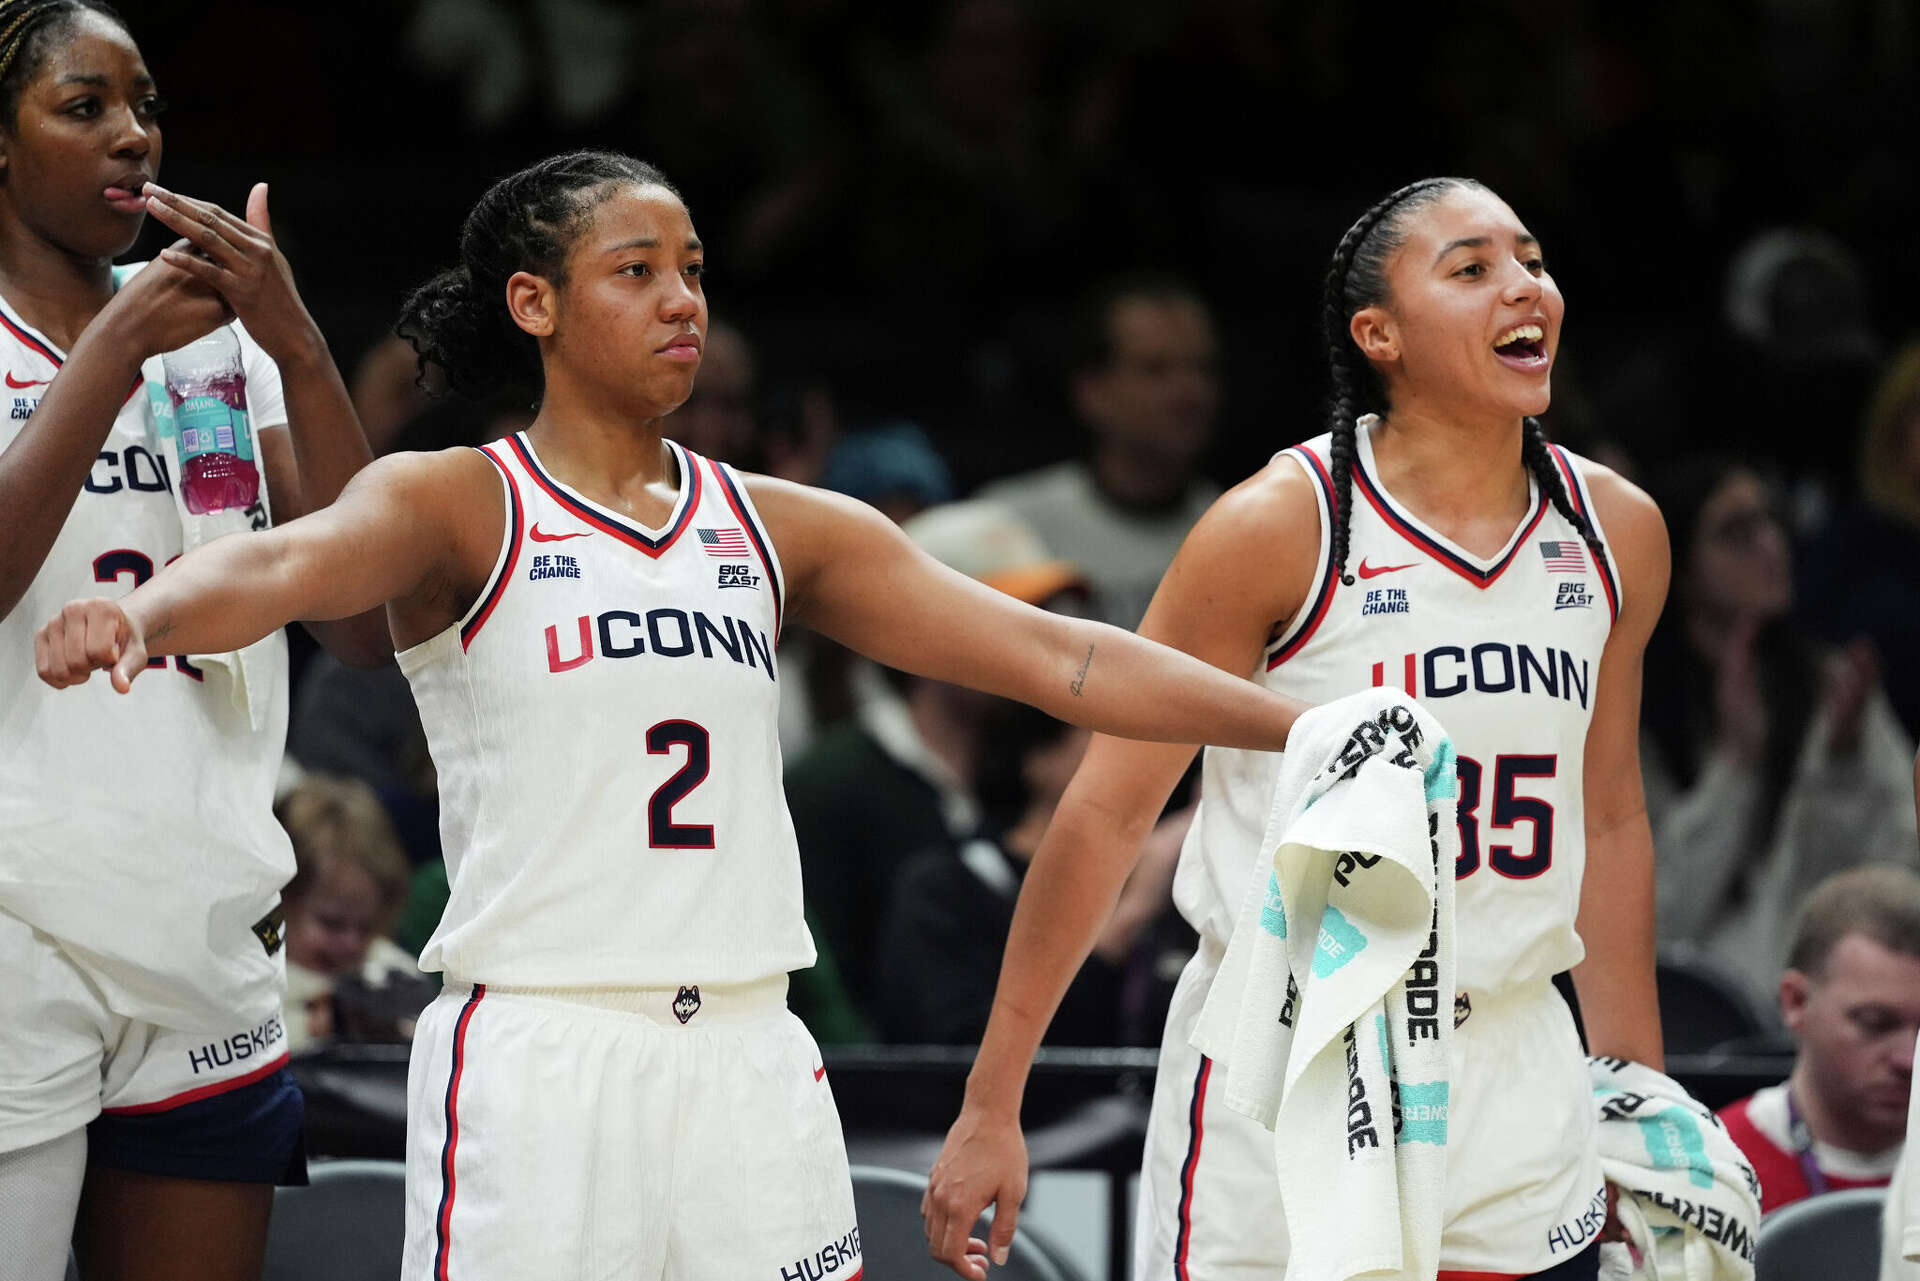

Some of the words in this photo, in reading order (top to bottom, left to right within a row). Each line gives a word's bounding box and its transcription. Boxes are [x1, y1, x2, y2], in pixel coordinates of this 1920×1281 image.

[533, 555, 550, 568] BE
[555, 555, 577, 567] THE
[529, 566, 581, 581] CHANGE
[719, 565, 748, 575] BIG
[718, 575, 760, 586] EAST
[1559, 583, 1584, 594] BIG
[1367, 590, 1381, 602] BE
[1387, 589, 1406, 600] THE
[1556, 594, 1594, 606] EAST
[1362, 601, 1409, 616] CHANGE
[545, 608, 775, 682] UCONN
[645, 718, 715, 849] 2
